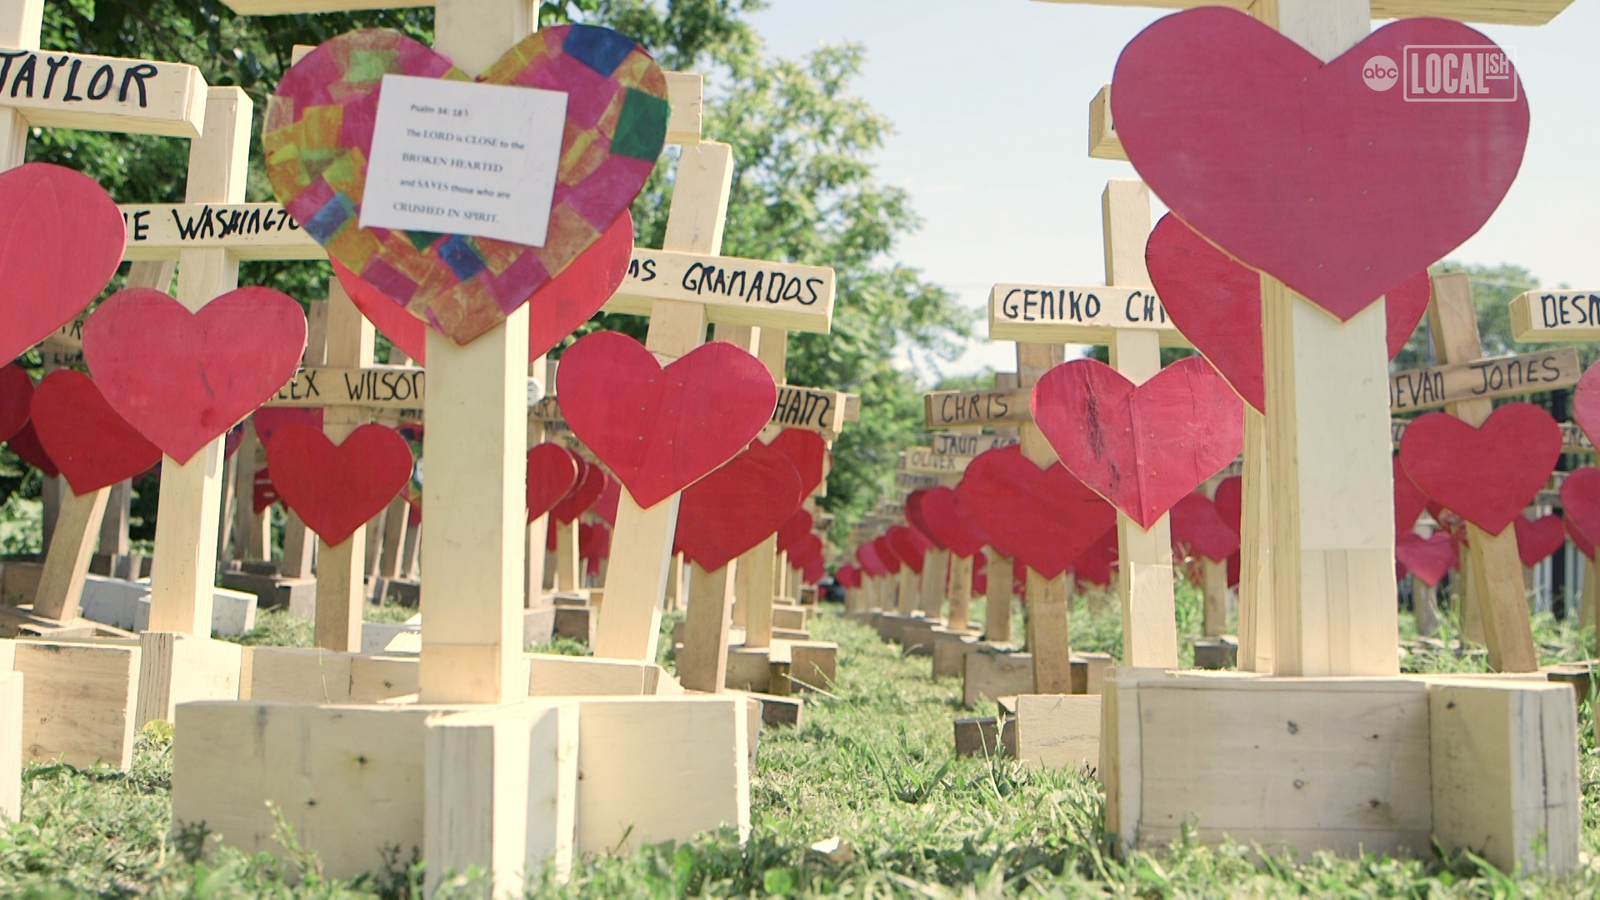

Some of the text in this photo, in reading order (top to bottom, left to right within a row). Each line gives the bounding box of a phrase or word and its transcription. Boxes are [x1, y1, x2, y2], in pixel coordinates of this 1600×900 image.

[0, 50, 158, 108] TAYLOR
[410, 104, 435, 113] Psalm
[406, 129, 421, 137] The
[423, 130, 455, 141] LORD
[456, 135, 463, 143] is
[465, 134, 498, 147] CLOSE
[511, 142, 525, 150] the
[402, 152, 503, 172] BROKEN HEARTED
[400, 179, 511, 199] and SAVES those who are
[393, 202, 445, 216] CRUSHED
[447, 208, 460, 218] IN
[1003, 288, 1101, 322] GENIKO
[344, 369, 426, 401] WILSON
[1389, 356, 1561, 408] EVAN JONES
[940, 393, 1009, 423] CHRIS
[910, 450, 956, 470] OLIVER
